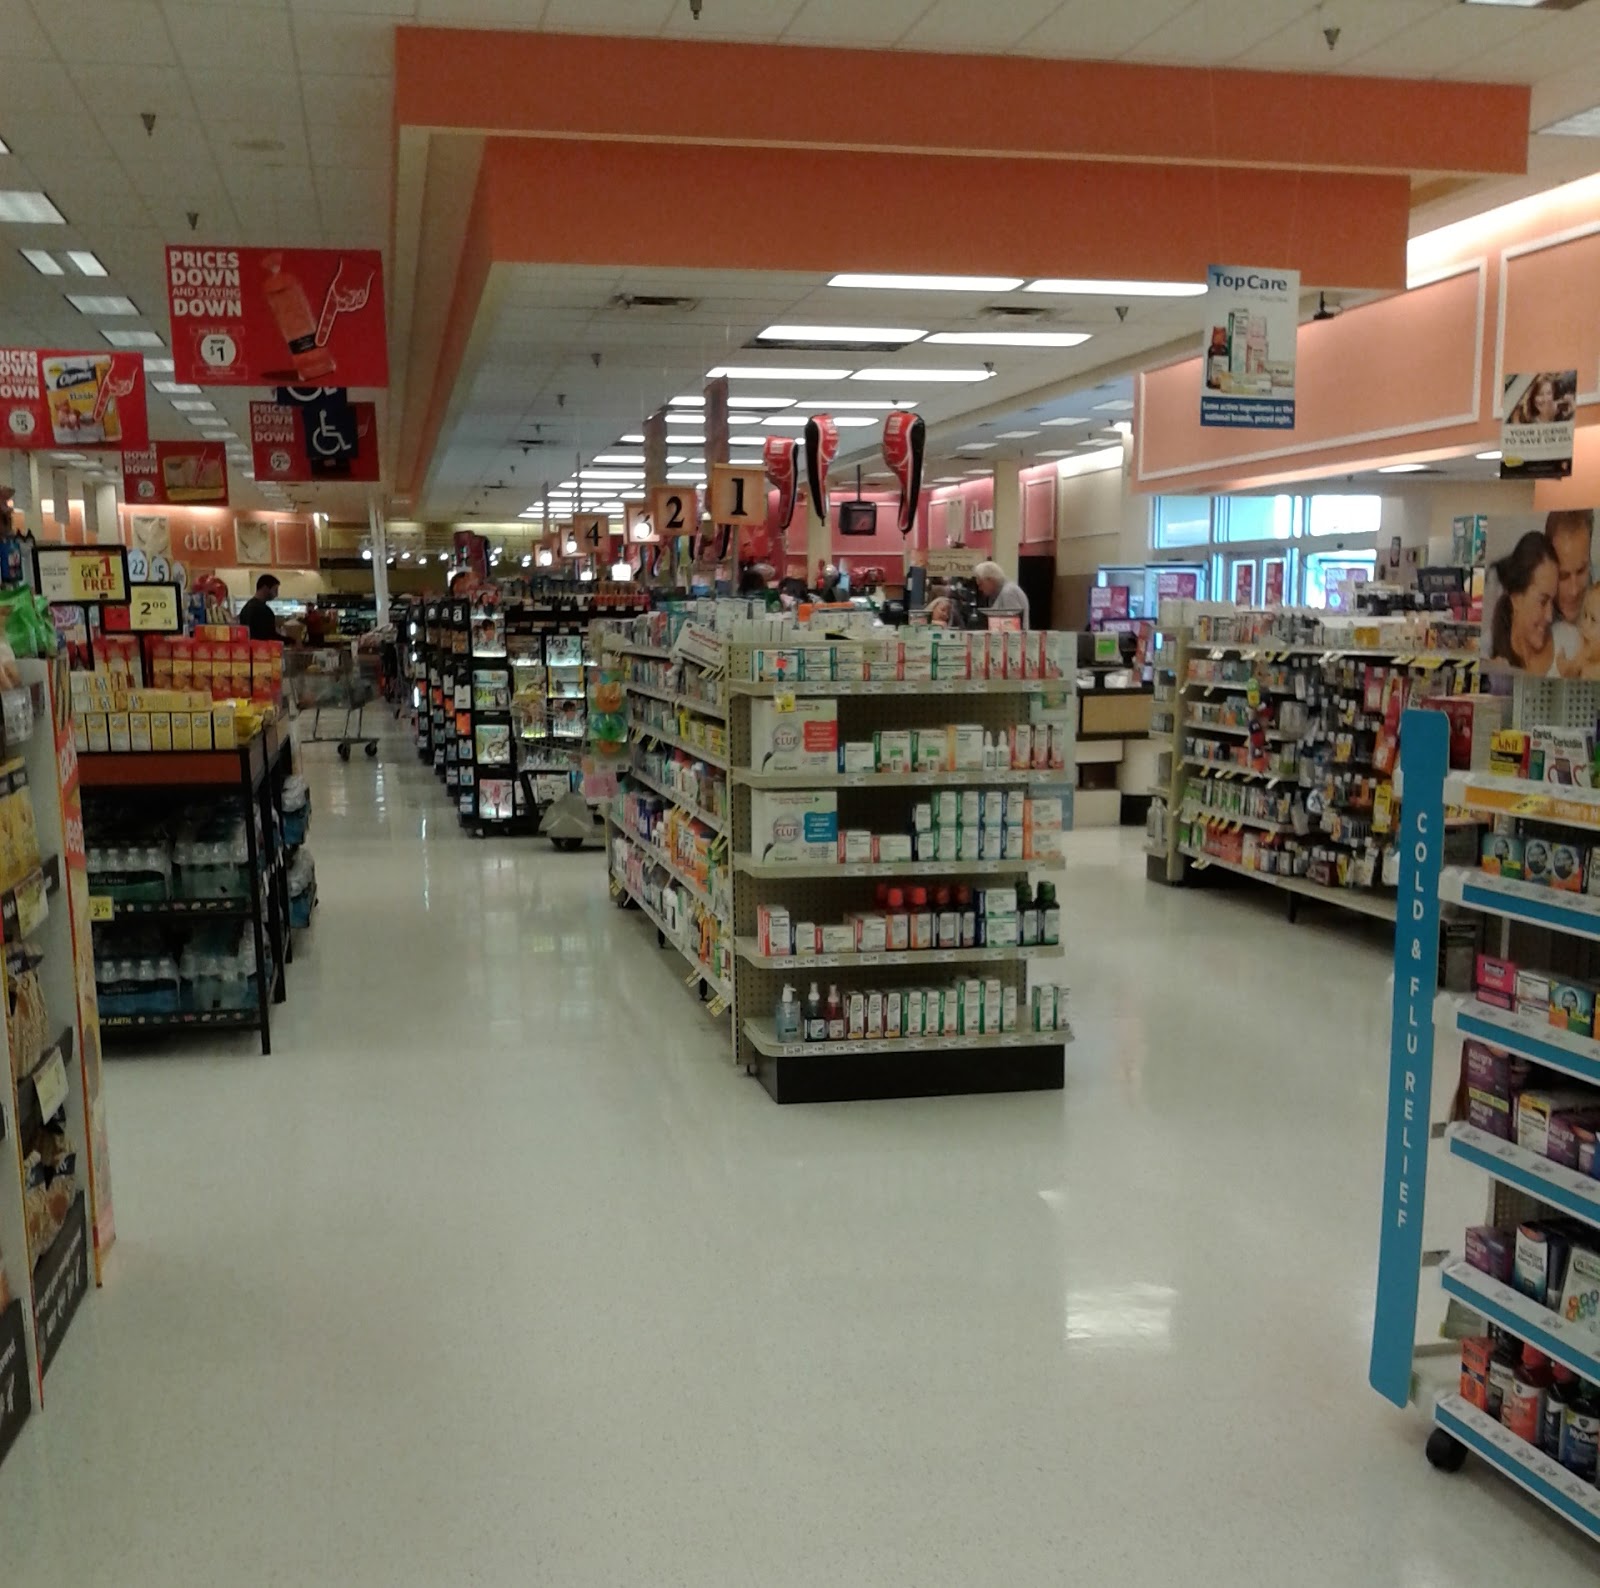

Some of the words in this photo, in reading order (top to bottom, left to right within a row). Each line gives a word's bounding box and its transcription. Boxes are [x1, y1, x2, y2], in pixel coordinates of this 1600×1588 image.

[169, 250, 240, 269] PRICES
[171, 268, 240, 286] DOWN
[1212, 271, 1288, 291] TopCare
[172, 287, 196, 297] AND
[197, 287, 242, 298] STAYING
[173, 299, 242, 317] DOWN
[253, 414, 293, 425] DOWN
[254, 431, 294, 443] DOWN
[730, 478, 748, 516] 1
[666, 496, 685, 529] 2
[184, 525, 224, 551] deli
[585, 521, 602, 547] 4
[81, 567, 100, 578] GET
[83, 578, 116, 592] FREE
[1413, 812, 1428, 920] COLD
[1407, 977, 1420, 1054] FLU
[1397, 1071, 1417, 1228] RELIEF
